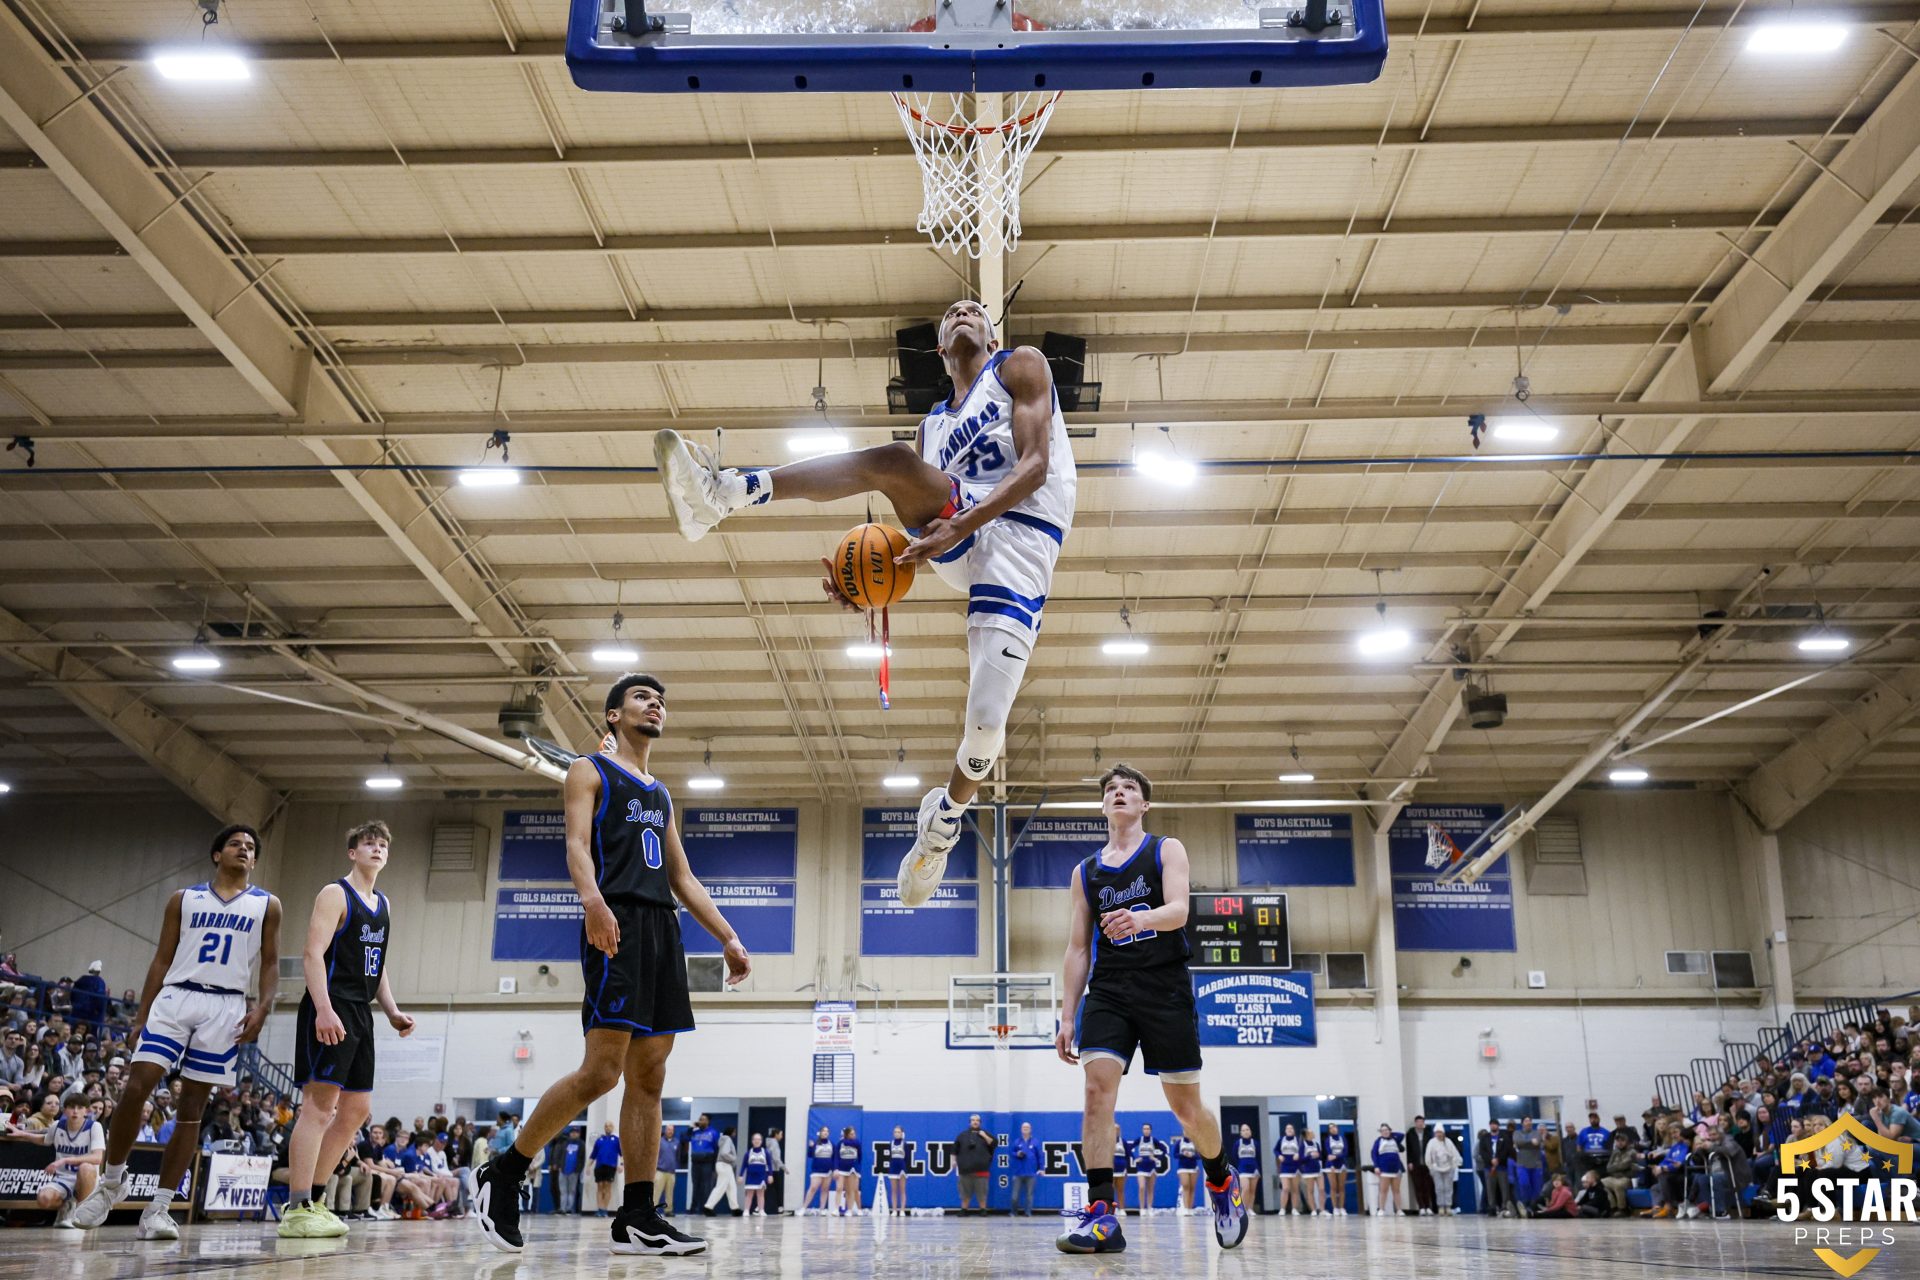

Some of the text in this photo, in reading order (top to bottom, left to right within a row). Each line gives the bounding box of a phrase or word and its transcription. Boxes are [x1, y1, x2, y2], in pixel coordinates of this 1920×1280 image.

[520, 814, 545, 824] GIRLS
[625, 798, 666, 828] Devil
[699, 812, 780, 822] GIRLS BASKETBALL
[881, 812, 919, 821] BOYS BAS
[1428, 808, 1485, 818] BASKETBALL
[1028, 822, 1109, 831] GIRLS BASKETBALL
[1254, 818, 1333, 828] BOYS BASKETBALL
[641, 828, 662, 869] 0
[705, 886, 778, 896] RLS BASKETBALL
[880, 888, 900, 898] BOYS
[1099, 874, 1152, 910] Devils
[1411, 882, 1492, 892] BOYS BASKETBALL
[513, 892, 539, 903] GIRLS
[1252, 896, 1280, 905] HOME
[1214, 897, 1243, 915] 1:04
[189, 911, 255, 933] HARRIMAN
[1257, 908, 1280, 926] 81
[1228, 921, 1237, 935] 4
[197, 931, 233, 966] 21
[364, 945, 382, 977] 13
[1198, 974, 1309, 999] HARRIMAN HIGH SCHOOL
[1215, 993, 1293, 1004] BOYS BASKETBALL
[1235, 1003, 1273, 1014] CLASS A
[1206, 1014, 1303, 1027] STATE CHAMPIONS
[1237, 1027, 1274, 1044] 2017
[872, 1141, 960, 1177] BLU
[0, 1181, 47, 1194] IGH SCH
[1071, 1185, 1082, 1210] ELLICO
